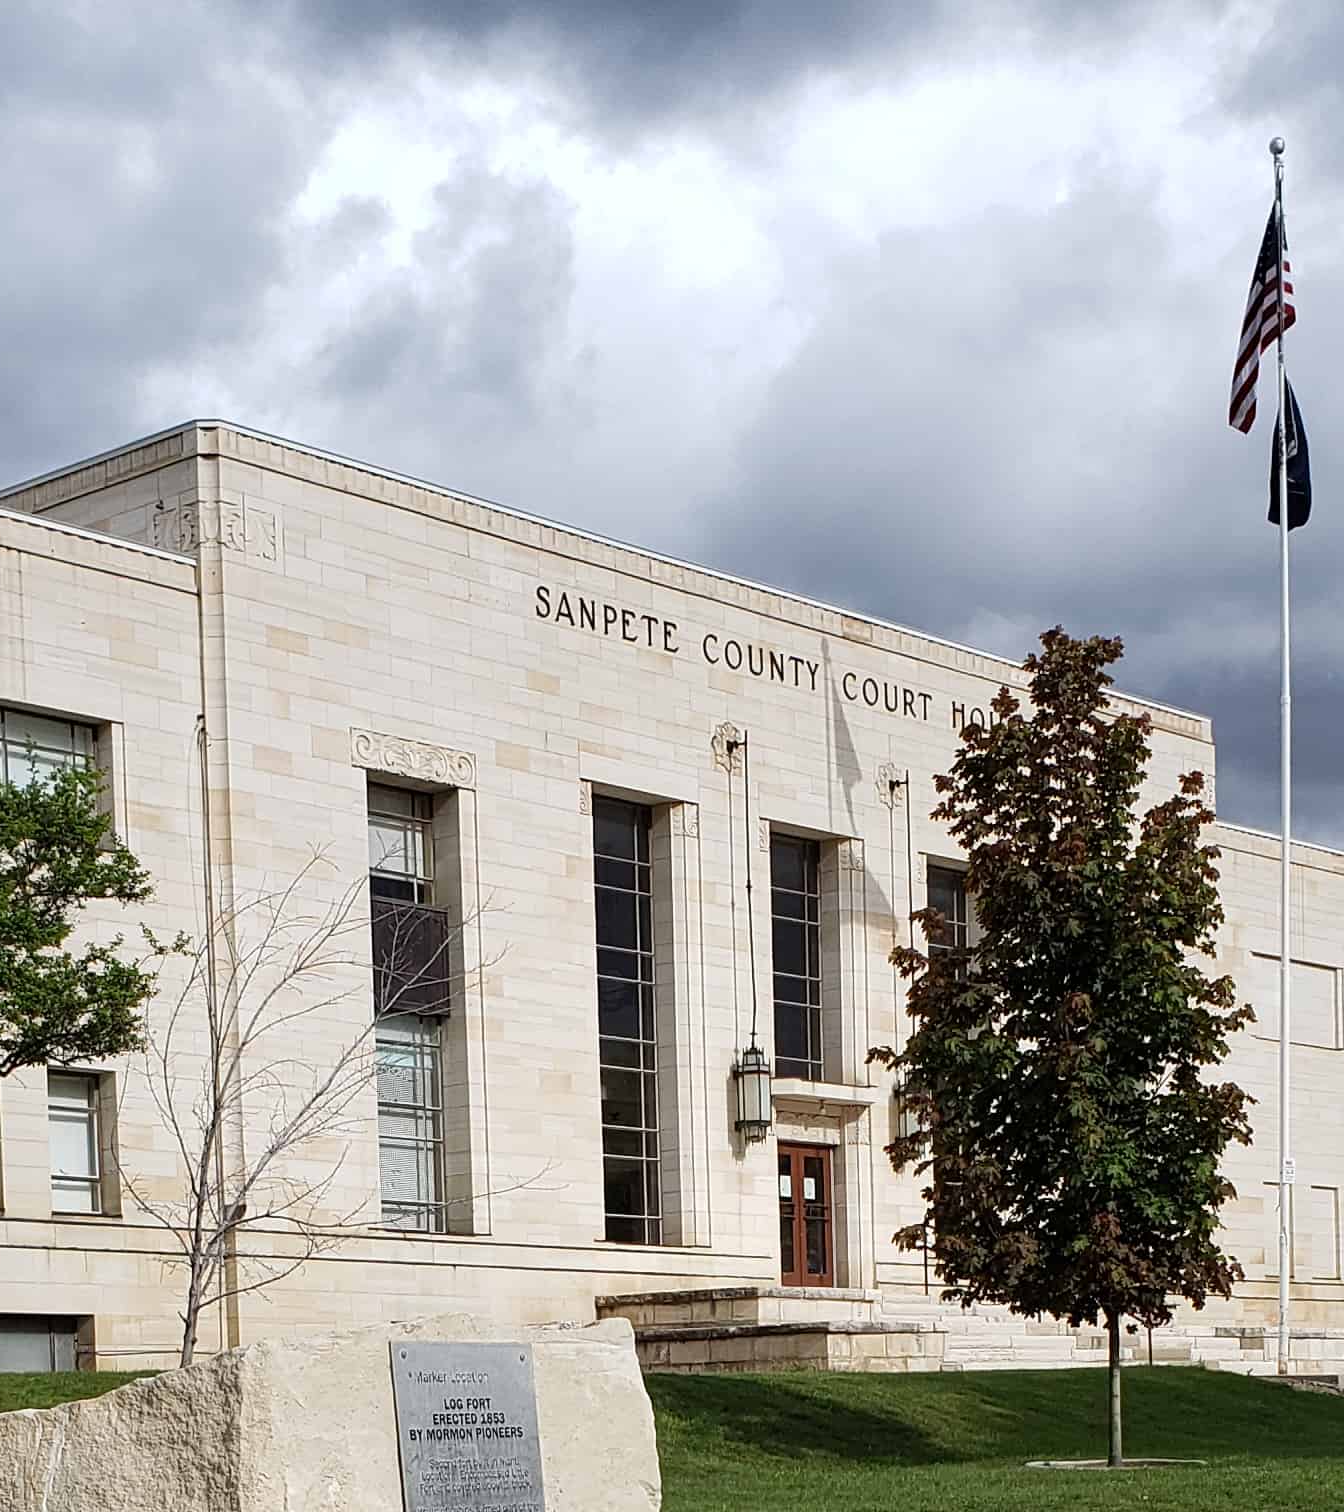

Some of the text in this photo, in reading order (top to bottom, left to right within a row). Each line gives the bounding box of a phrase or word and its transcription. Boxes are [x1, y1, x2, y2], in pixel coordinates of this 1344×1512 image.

[535, 585, 680, 654] SANPETE
[702, 633, 820, 691] COUNTY
[842, 671, 933, 721] COURT
[443, 1398, 492, 1411] LOG FORT
[432, 1413, 478, 1426] ERECTED
[409, 1426, 524, 1441] BY MORMON PIONEERS
